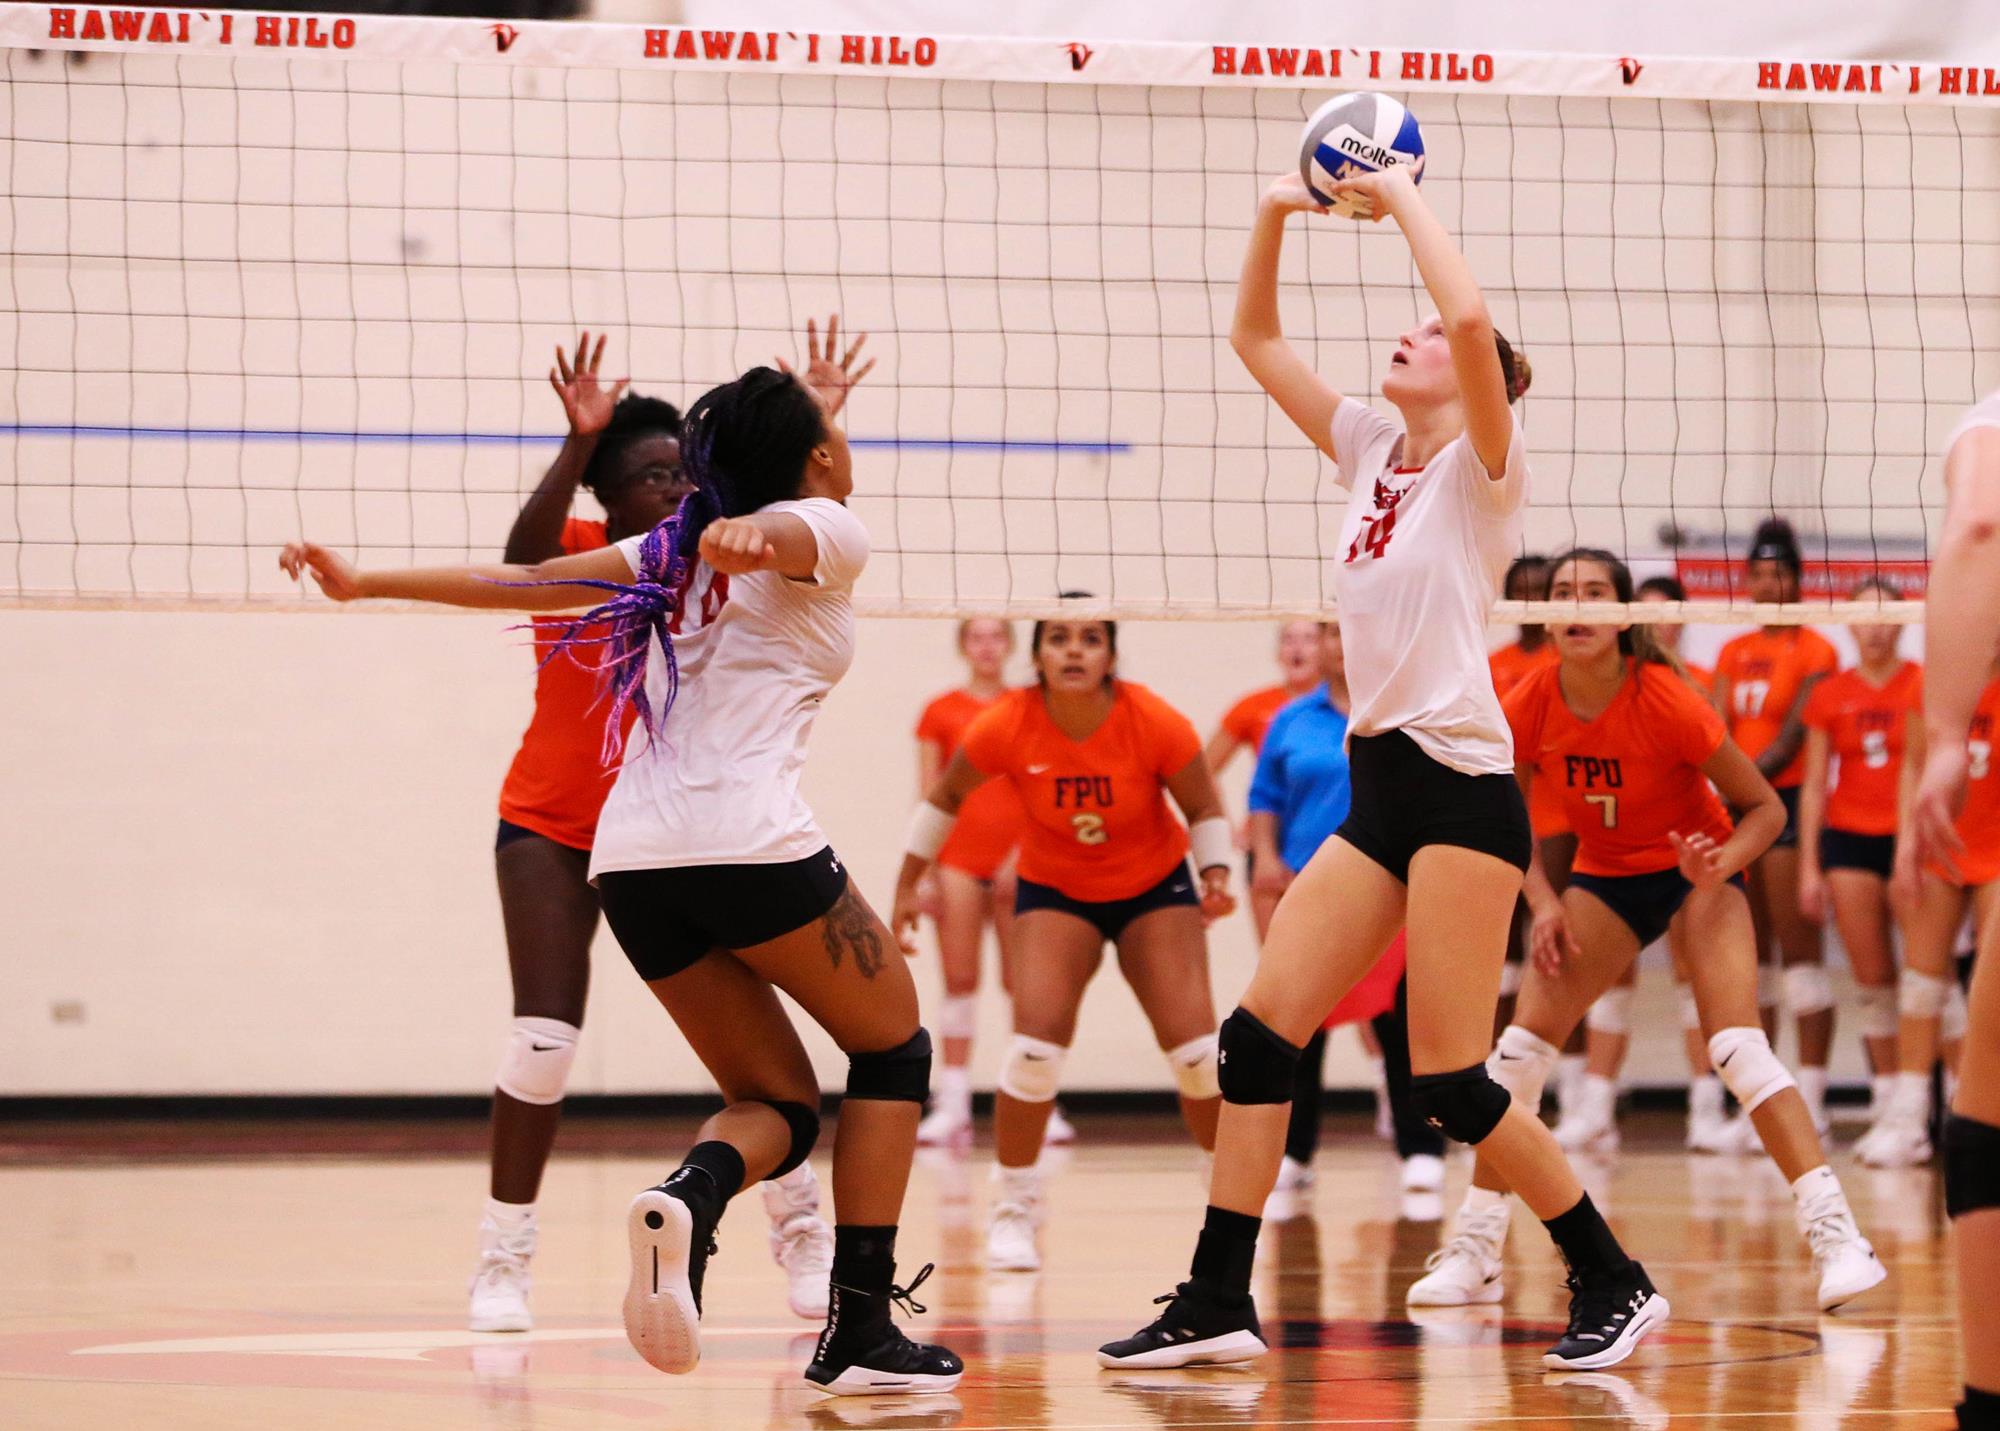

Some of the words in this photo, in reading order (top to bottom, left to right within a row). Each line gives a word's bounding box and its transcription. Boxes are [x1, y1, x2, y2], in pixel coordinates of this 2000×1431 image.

[254, 16, 356, 49] HILO
[840, 35, 937, 67] HILO
[1400, 53, 1494, 83] HILO
[1340, 136, 1397, 170] molte
[1733, 680, 1770, 719] 17
[1564, 755, 1623, 788] FPU
[1055, 776, 1114, 808] FPU
[1584, 794, 1617, 828] 7
[1071, 812, 1107, 845] 2
